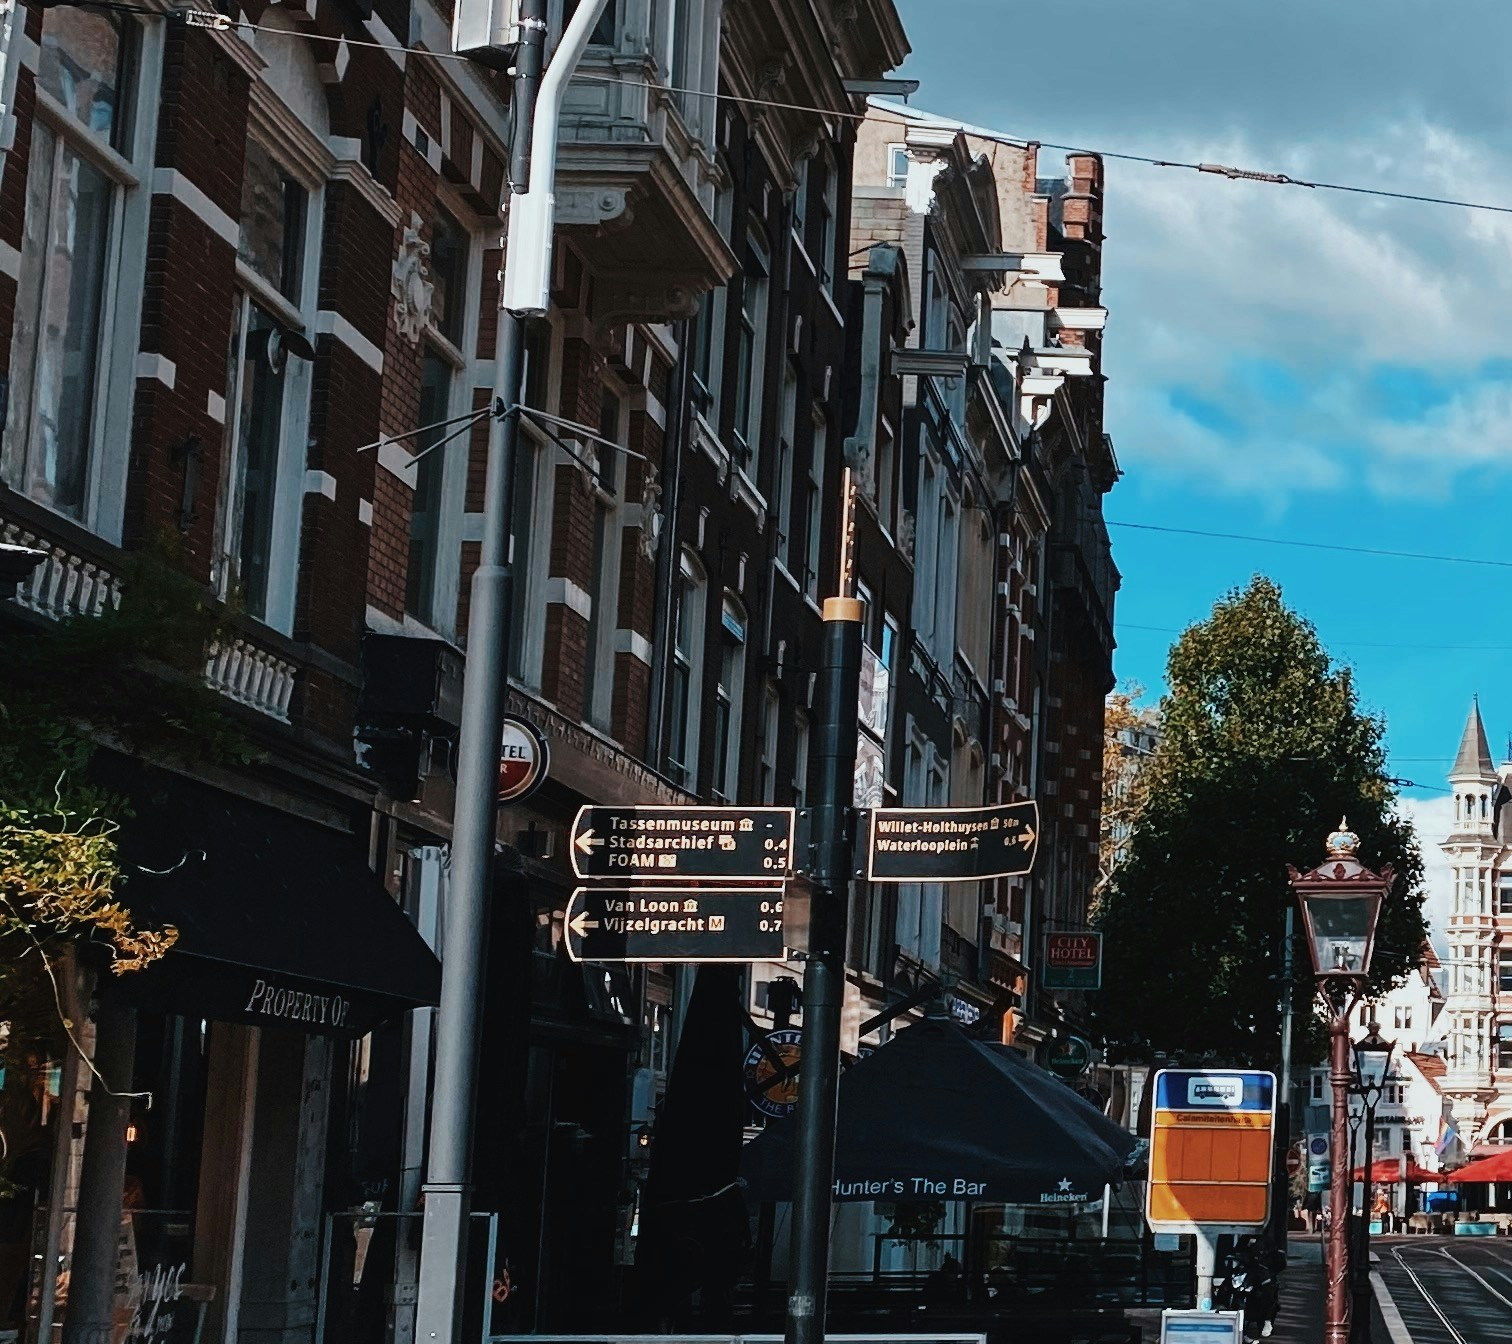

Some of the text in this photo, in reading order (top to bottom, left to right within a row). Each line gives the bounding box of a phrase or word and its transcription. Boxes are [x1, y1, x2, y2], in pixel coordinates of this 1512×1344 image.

[610, 817, 735, 832] Tassenmuseum
[878, 820, 989, 835] Willet-Holthuysen
[609, 835, 715, 850] Stadsarchief
[877, 838, 968, 854] Waterlooplein
[608, 854, 655, 868] FOAM
[605, 899, 635, 912] Van
[640, 898, 680, 913] Loon
[604, 917, 705, 935] Vijzelgracht
[1057, 936, 1090, 948] CITY
[1050, 947, 1095, 960] HOTEL
[911, 1177, 947, 1195] The
[953, 1178, 988, 1196] Bar
[1040, 1192, 1087, 1203] Heineken
